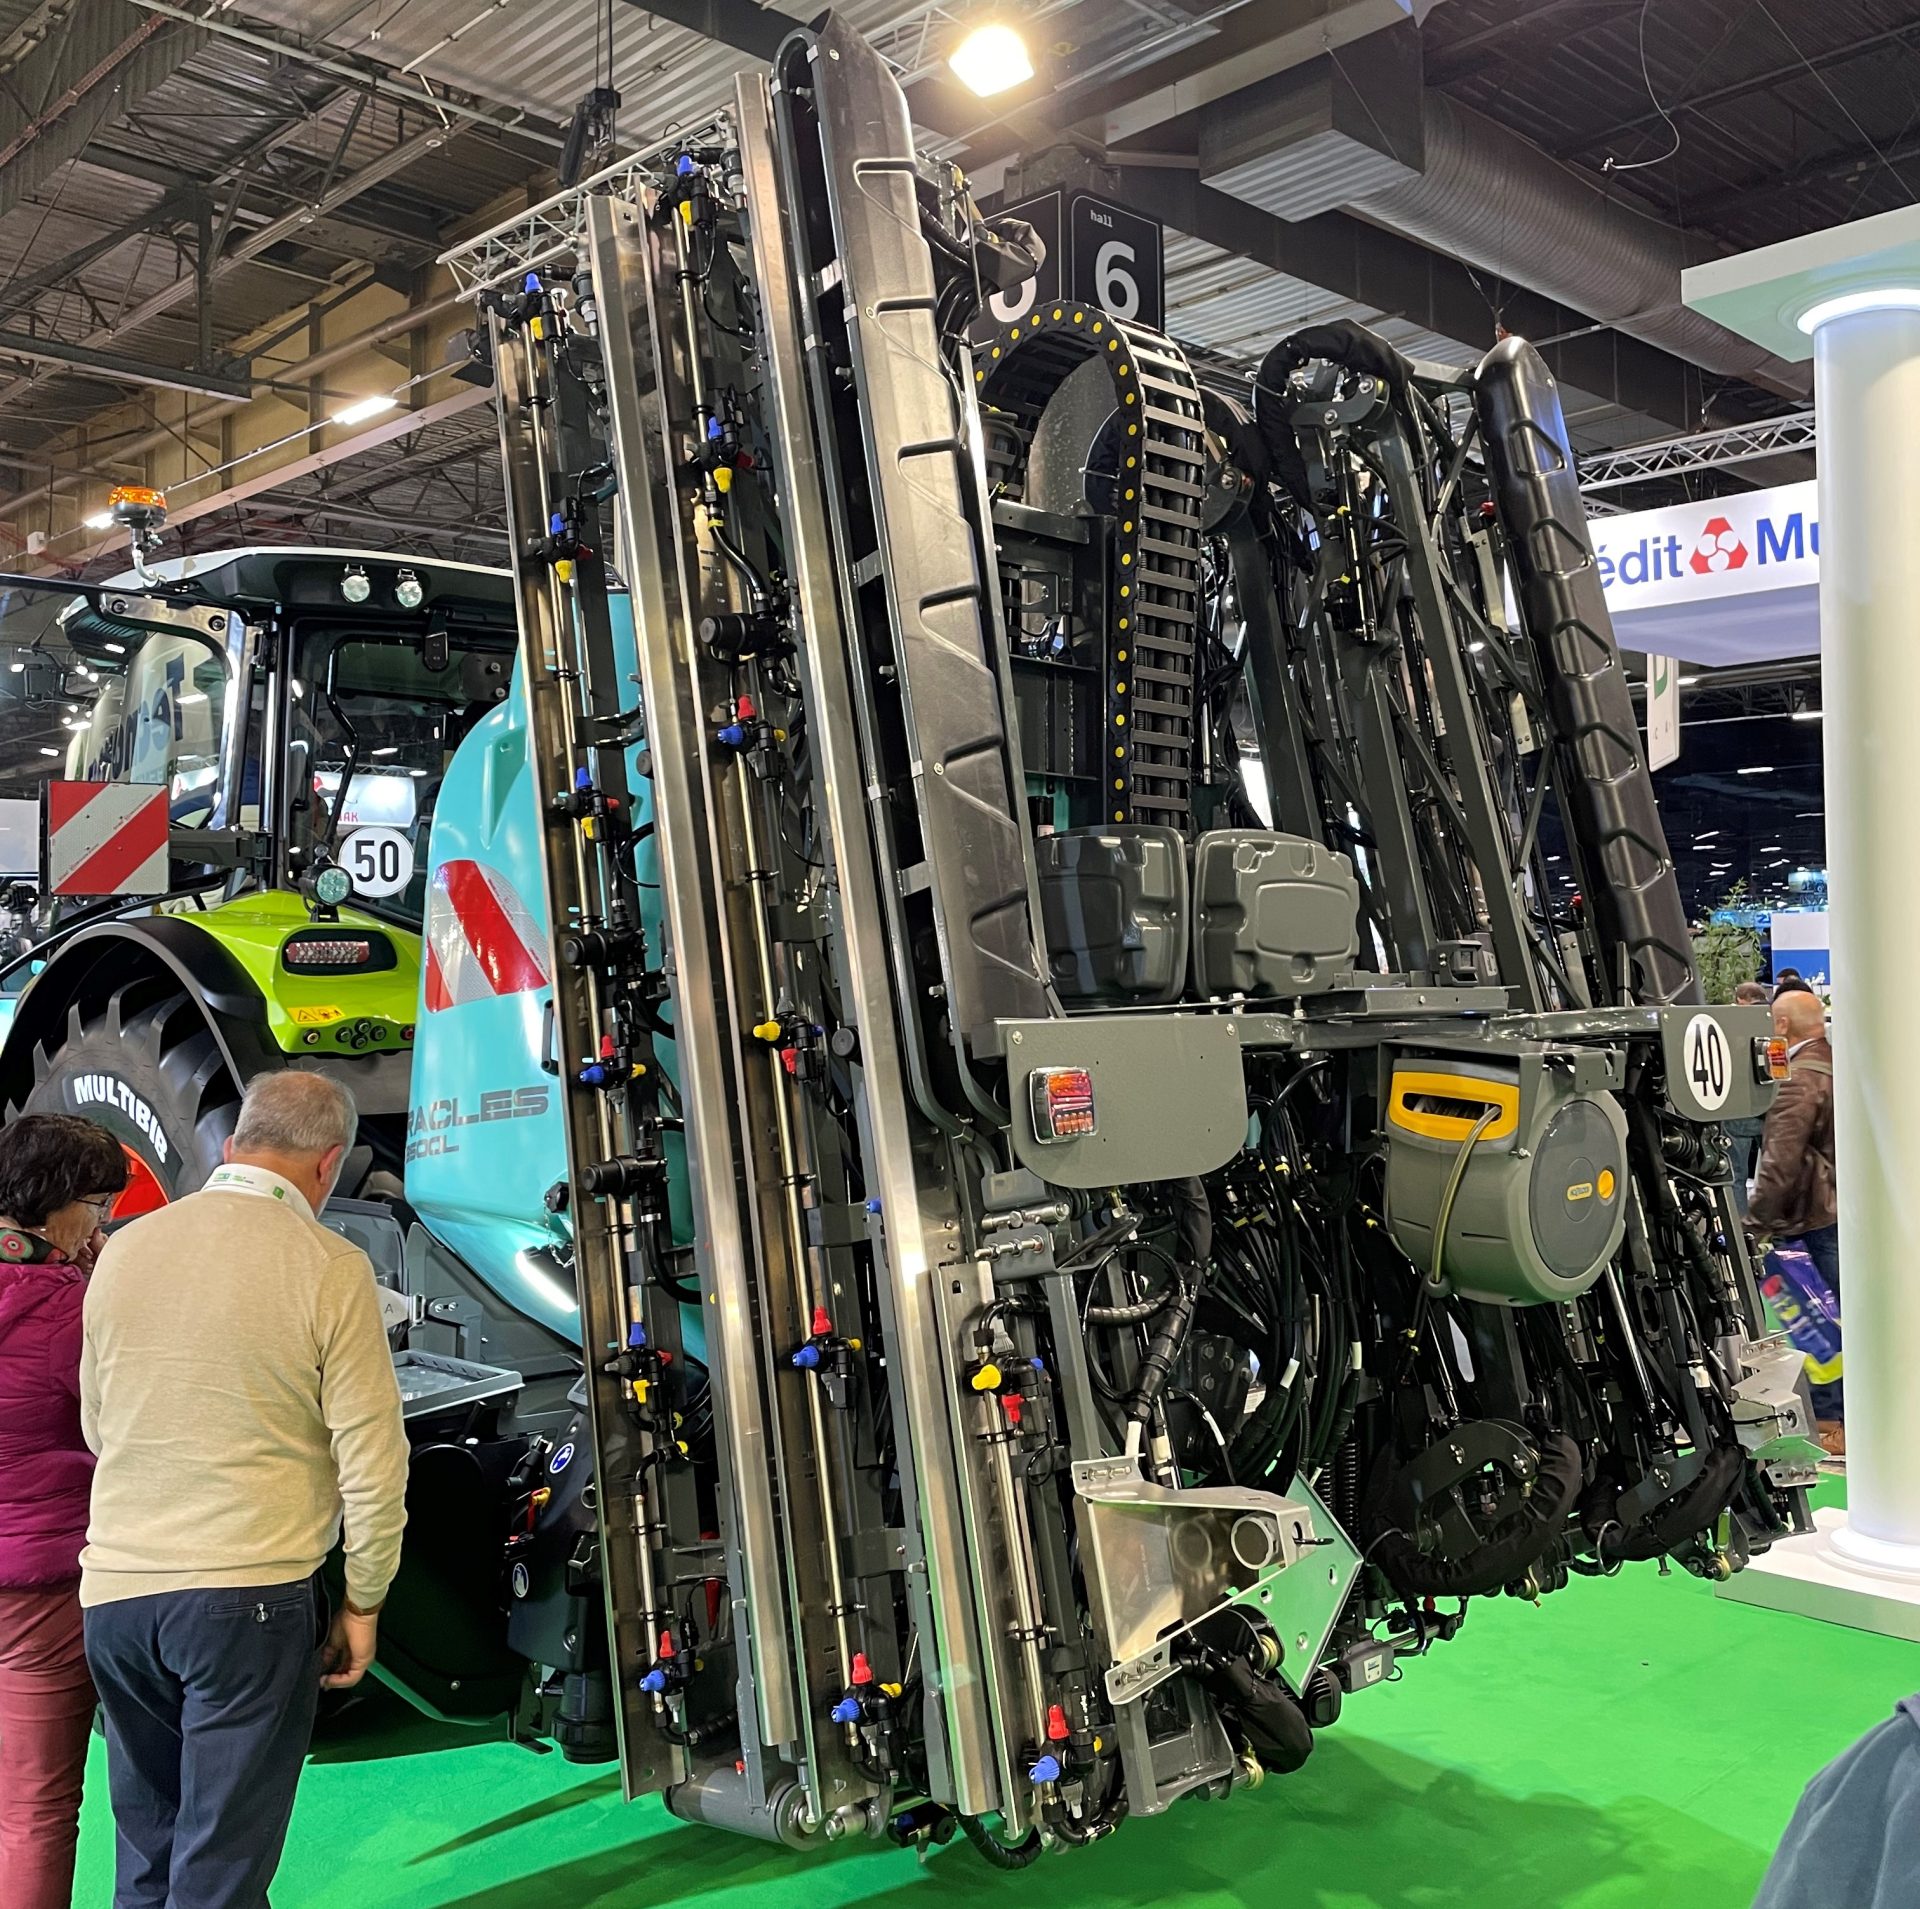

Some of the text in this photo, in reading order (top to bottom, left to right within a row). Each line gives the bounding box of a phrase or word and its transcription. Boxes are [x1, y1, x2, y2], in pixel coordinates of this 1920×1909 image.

[1090, 209, 1113, 228] hall
[1095, 240, 1140, 320] 6
[355, 840, 399, 882] 50
[1693, 1024, 1724, 1096] 40
[73, 1074, 168, 1164] MULTIBIB
[383, 1303, 394, 1314] A
